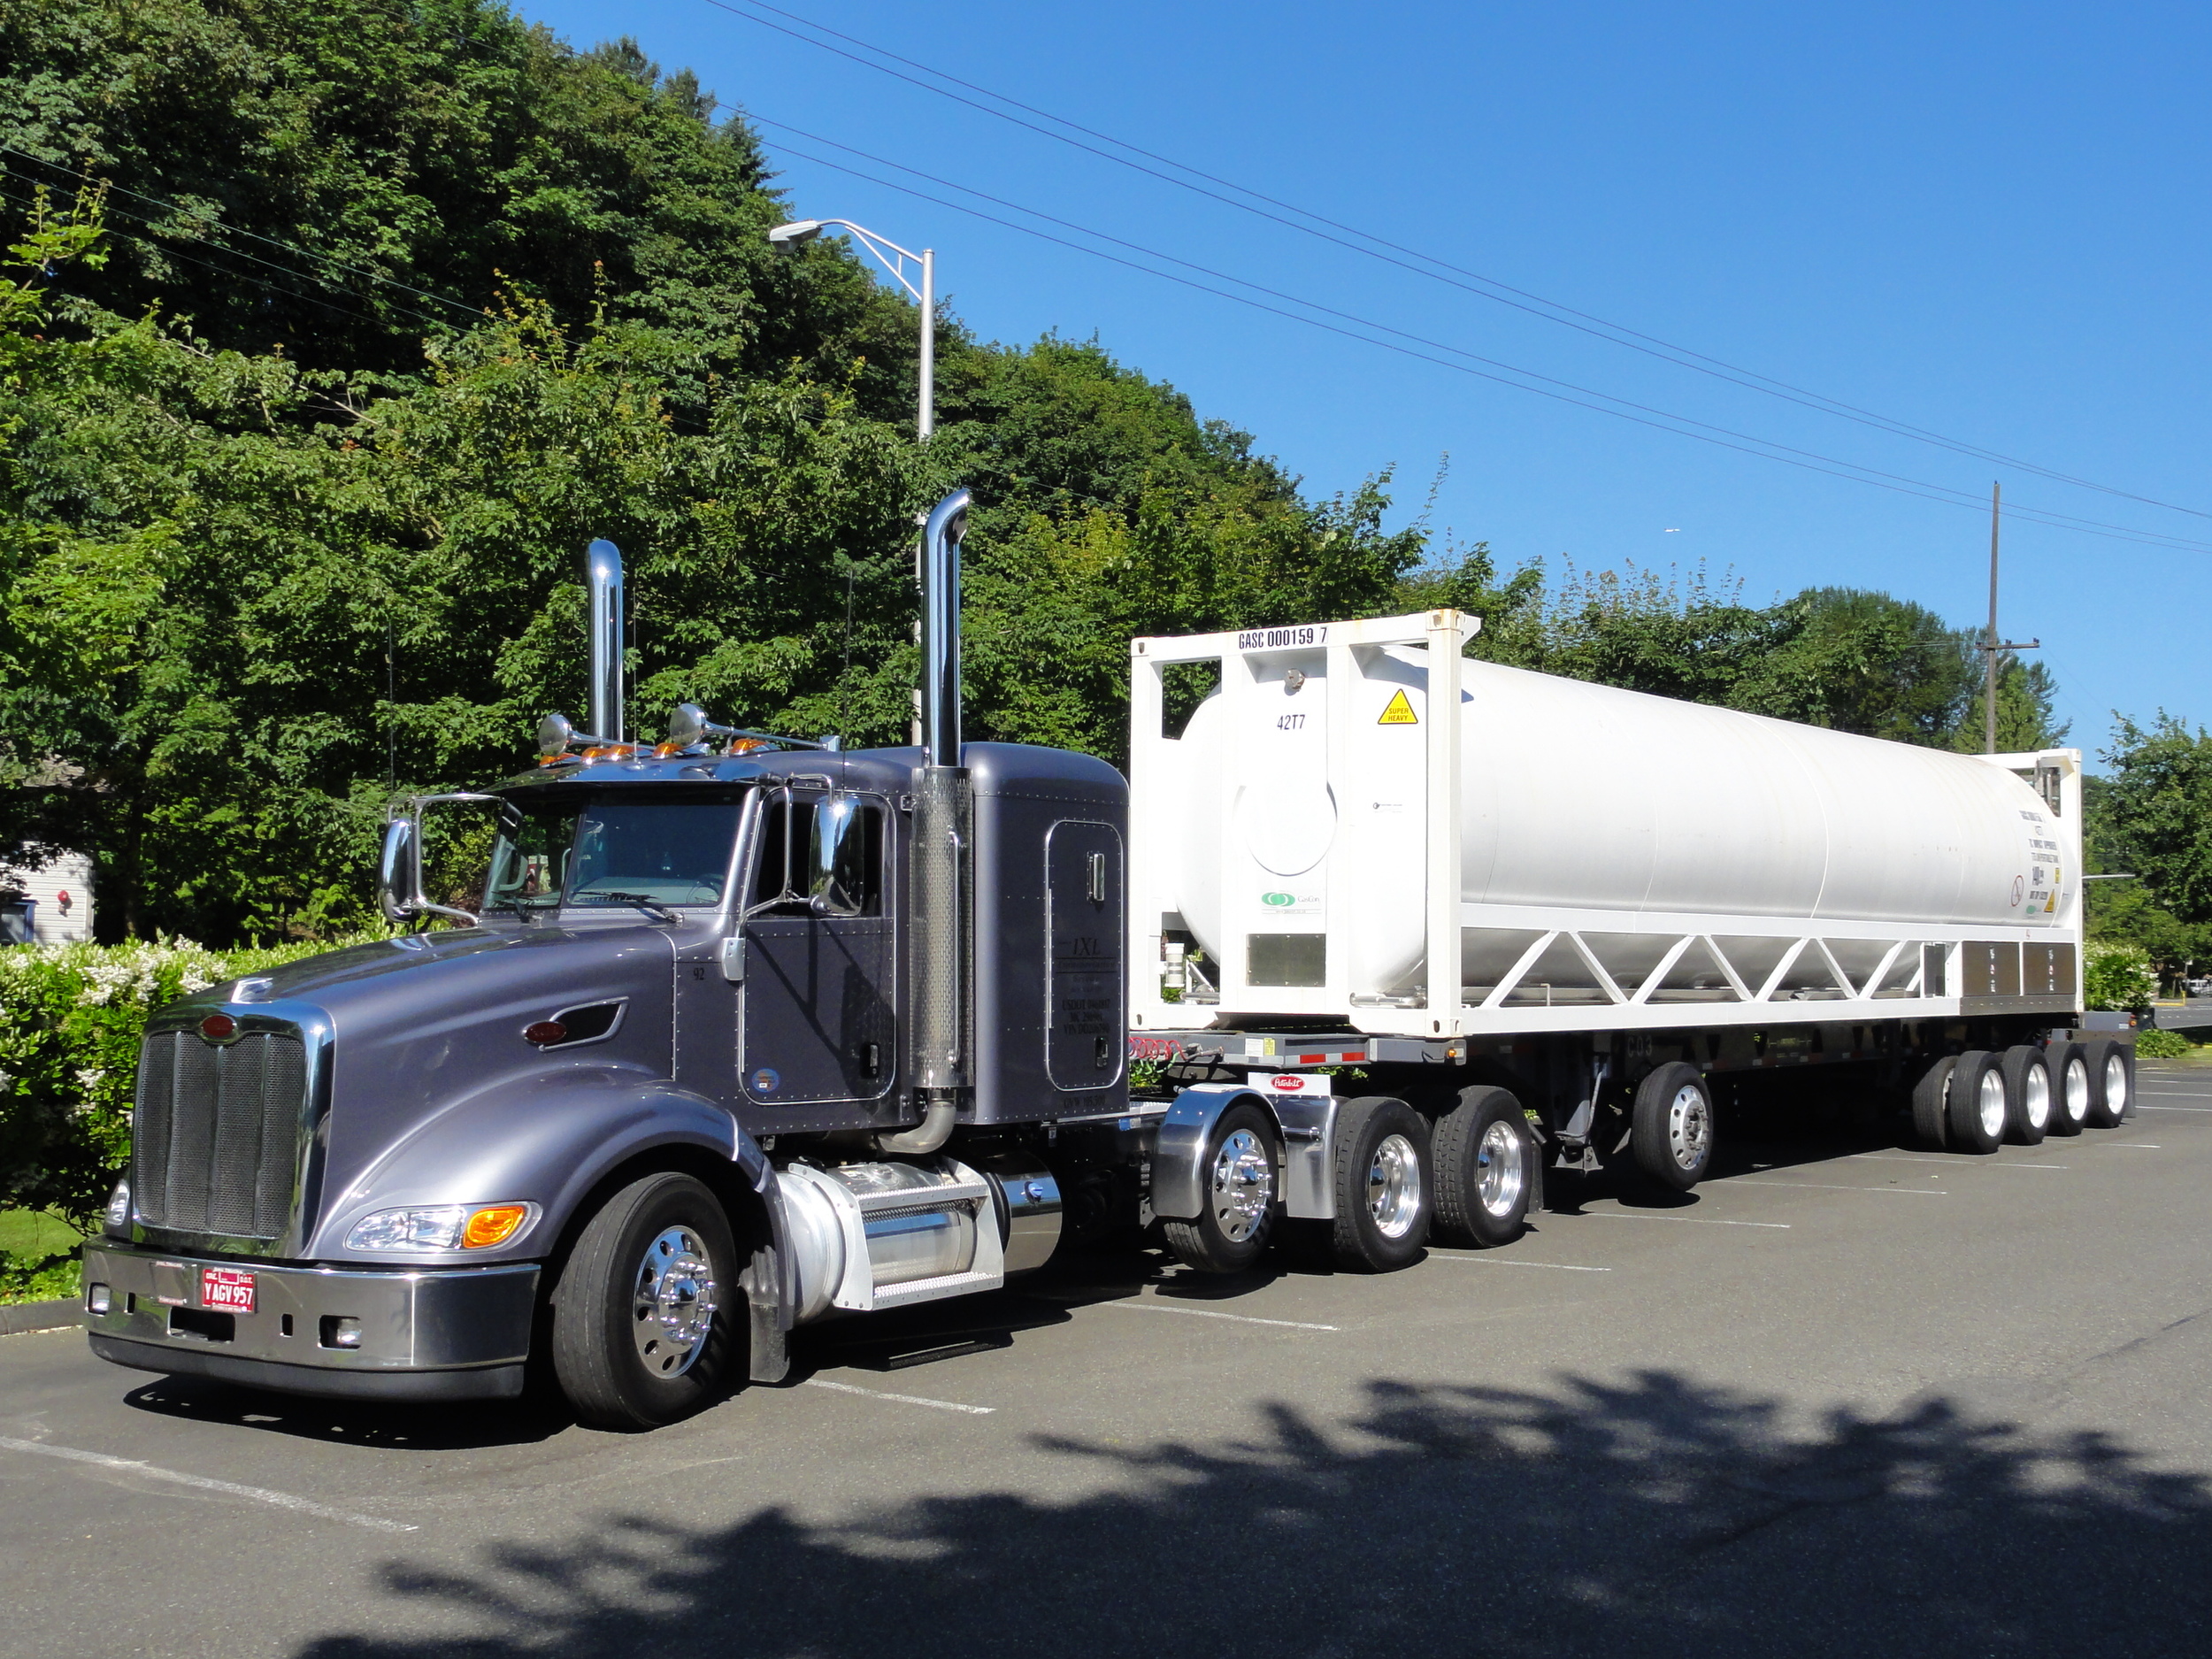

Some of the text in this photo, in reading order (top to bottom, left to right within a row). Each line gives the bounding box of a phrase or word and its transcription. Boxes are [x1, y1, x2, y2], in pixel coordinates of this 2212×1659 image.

[1239, 626, 1328, 649] GASC 000159 7
[1277, 714, 1305, 730] 42T7
[1072, 937, 1101, 956] IXL
[693, 967, 705, 981] 92
[1274, 1078, 1303, 1087] Peterbilt
